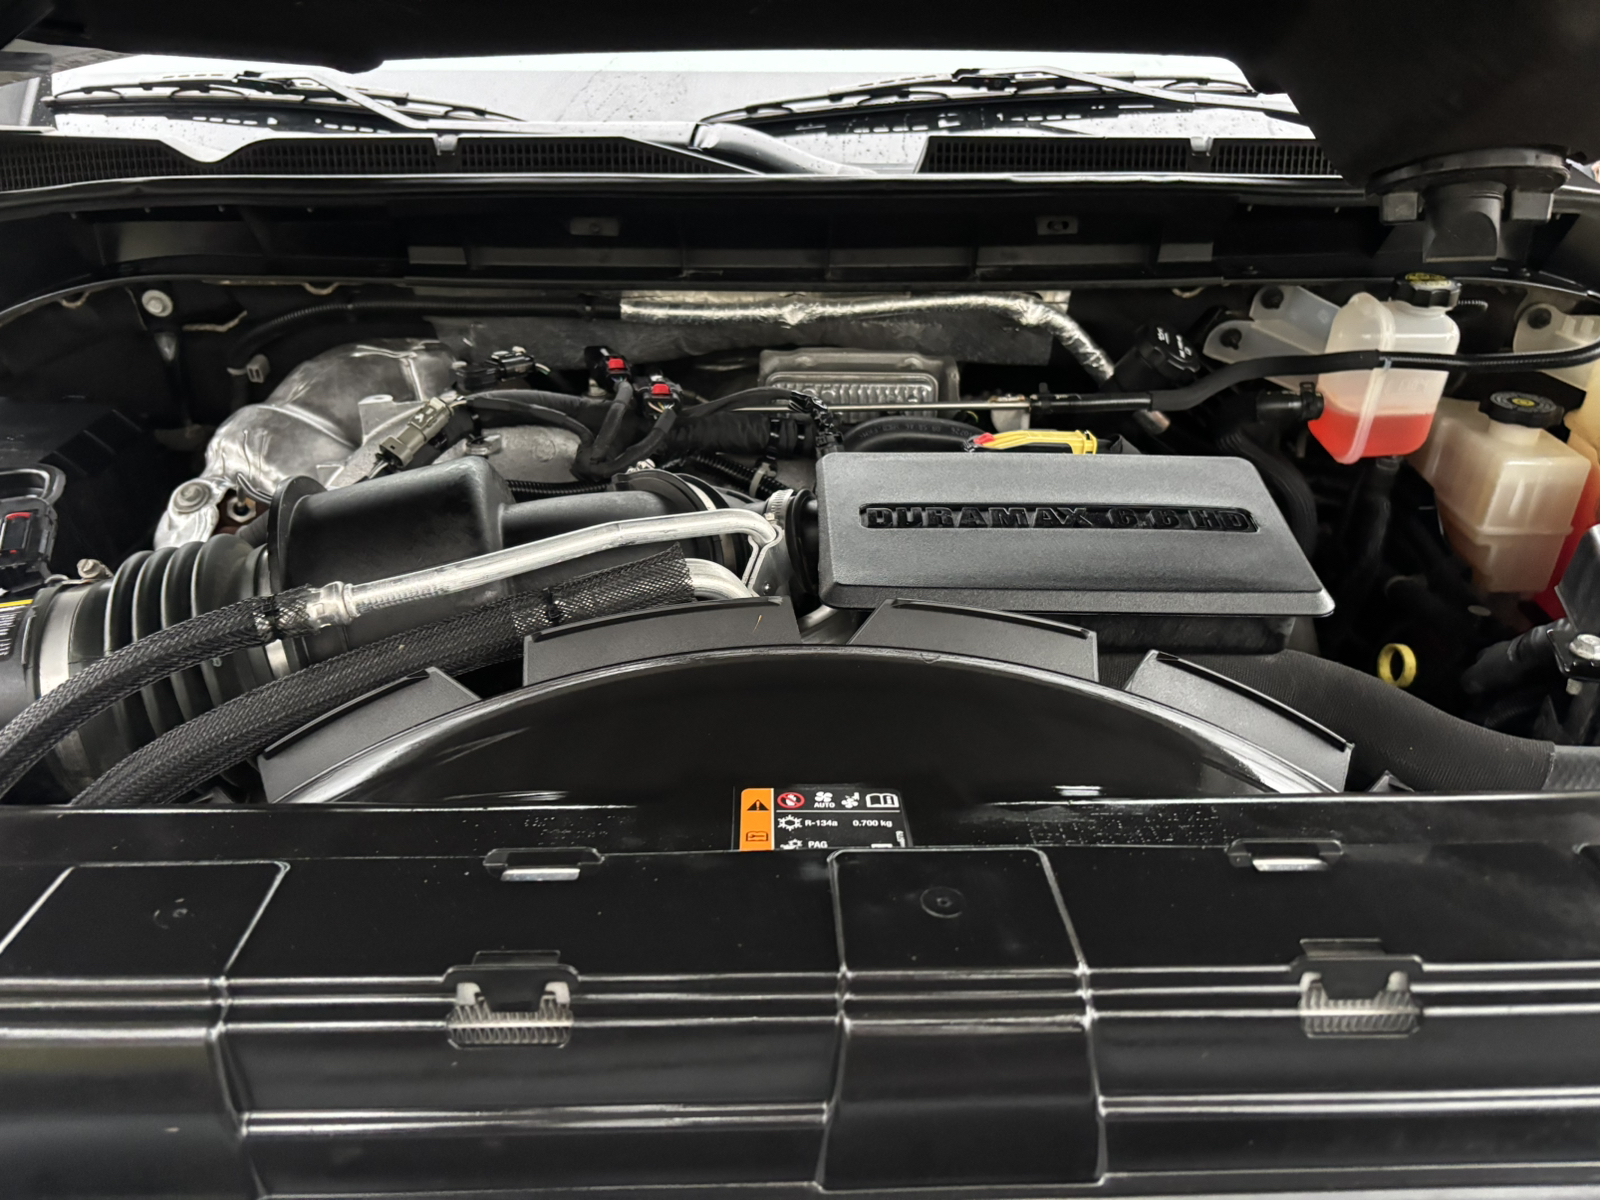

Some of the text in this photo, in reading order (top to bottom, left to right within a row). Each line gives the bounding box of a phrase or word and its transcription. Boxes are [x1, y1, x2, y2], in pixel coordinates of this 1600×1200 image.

[865, 506, 1252, 531] DURAMAX 6.6 HD
[880, 820, 893, 828] kg
